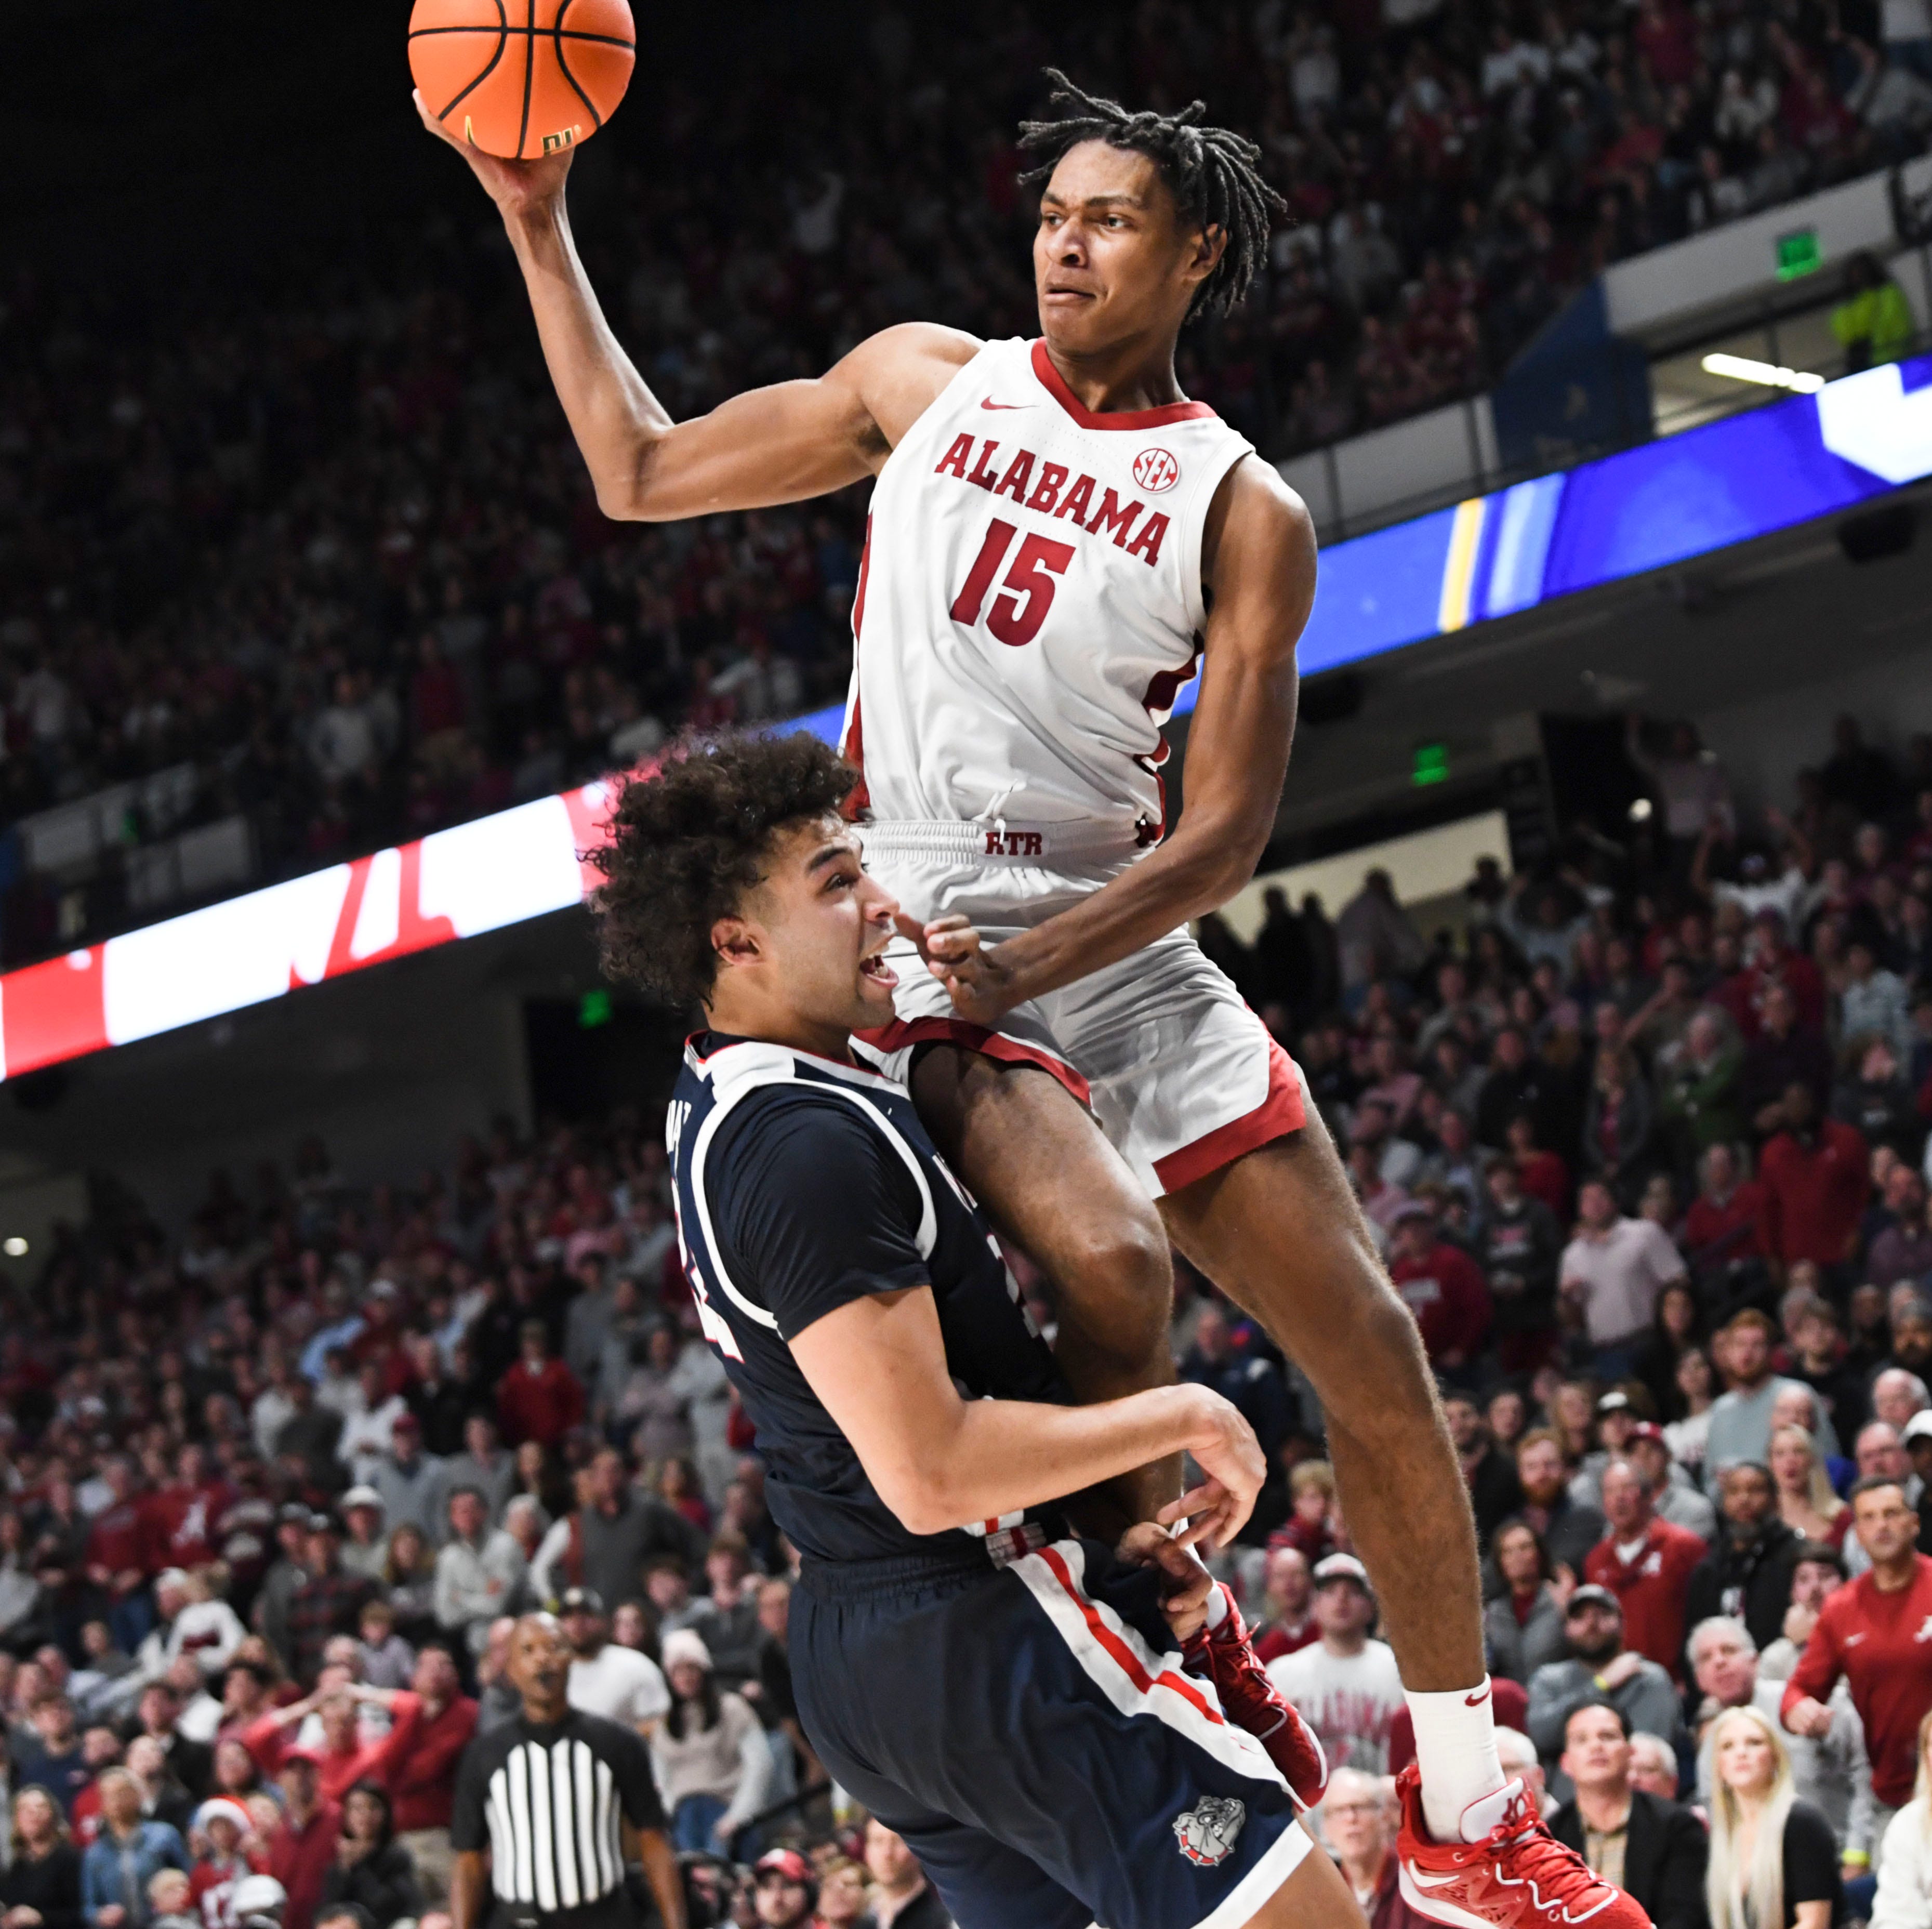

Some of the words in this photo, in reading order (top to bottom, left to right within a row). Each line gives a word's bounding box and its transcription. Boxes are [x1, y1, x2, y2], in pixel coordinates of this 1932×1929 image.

[934, 432, 1171, 567] ALABAMA
[1133, 448, 1178, 491] SEC
[949, 517, 1077, 646] 15
[985, 832, 1042, 856] RTR
